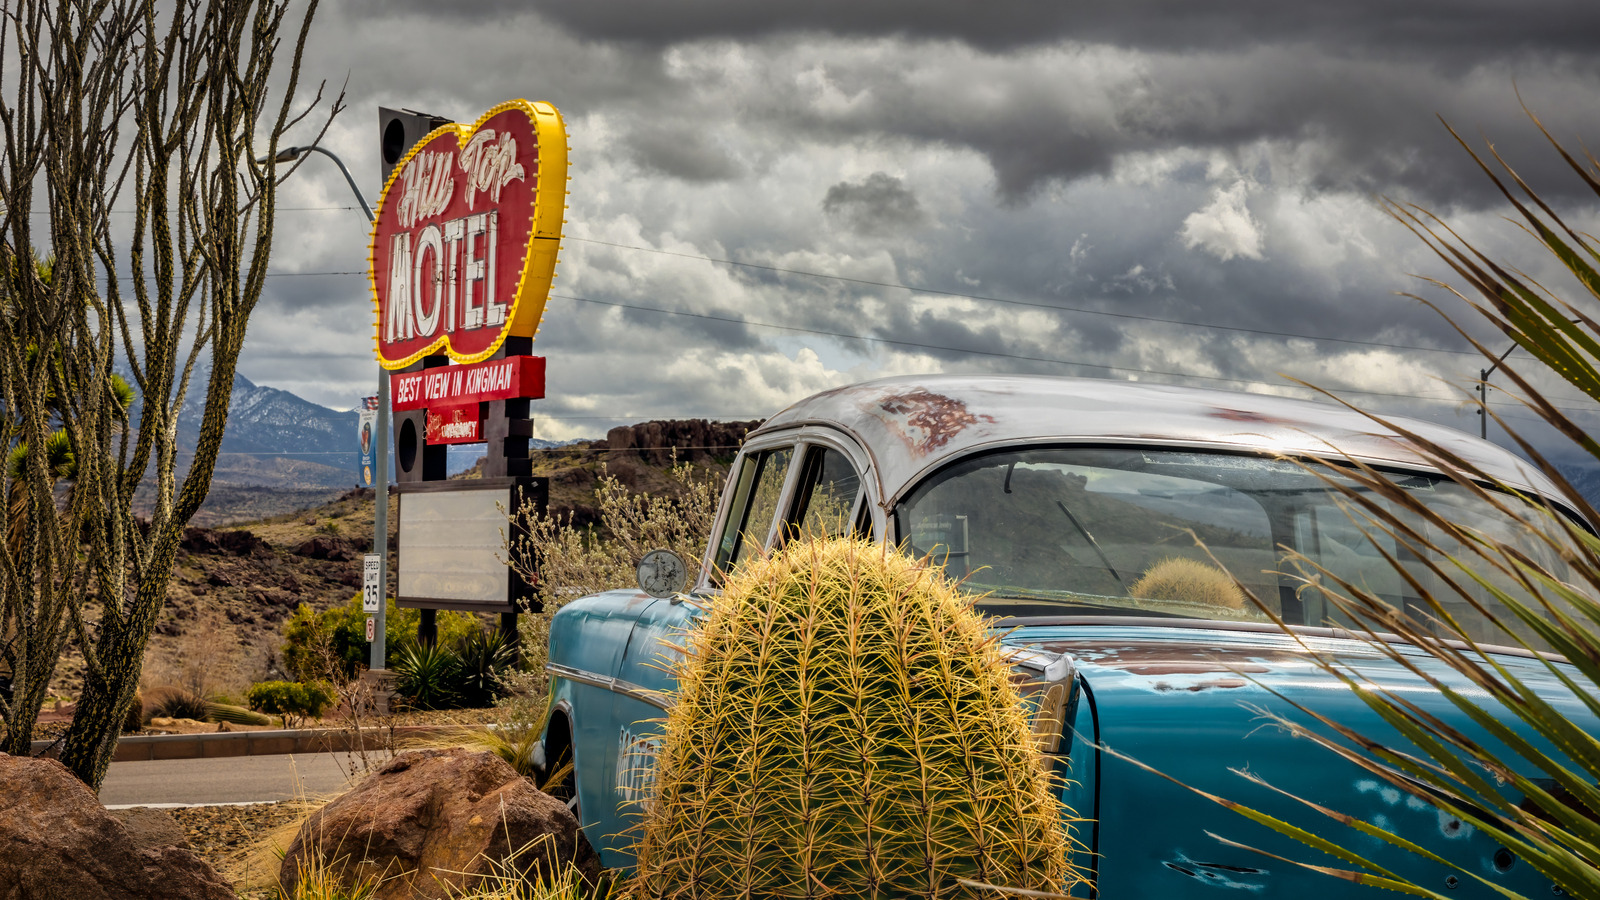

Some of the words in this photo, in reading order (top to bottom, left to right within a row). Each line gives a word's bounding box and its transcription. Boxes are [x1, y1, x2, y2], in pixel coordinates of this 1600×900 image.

[458, 129, 525, 211] Top
[384, 209, 507, 344] MOTEL
[398, 377, 422, 403] BEST
[425, 372, 450, 400] VIEW
[451, 370, 463, 397] IN
[465, 363, 513, 395] KINGMAN
[366, 561, 378, 570] SPEED
[366, 573, 377, 581] LIMIT
[365, 585, 378, 605] 35
